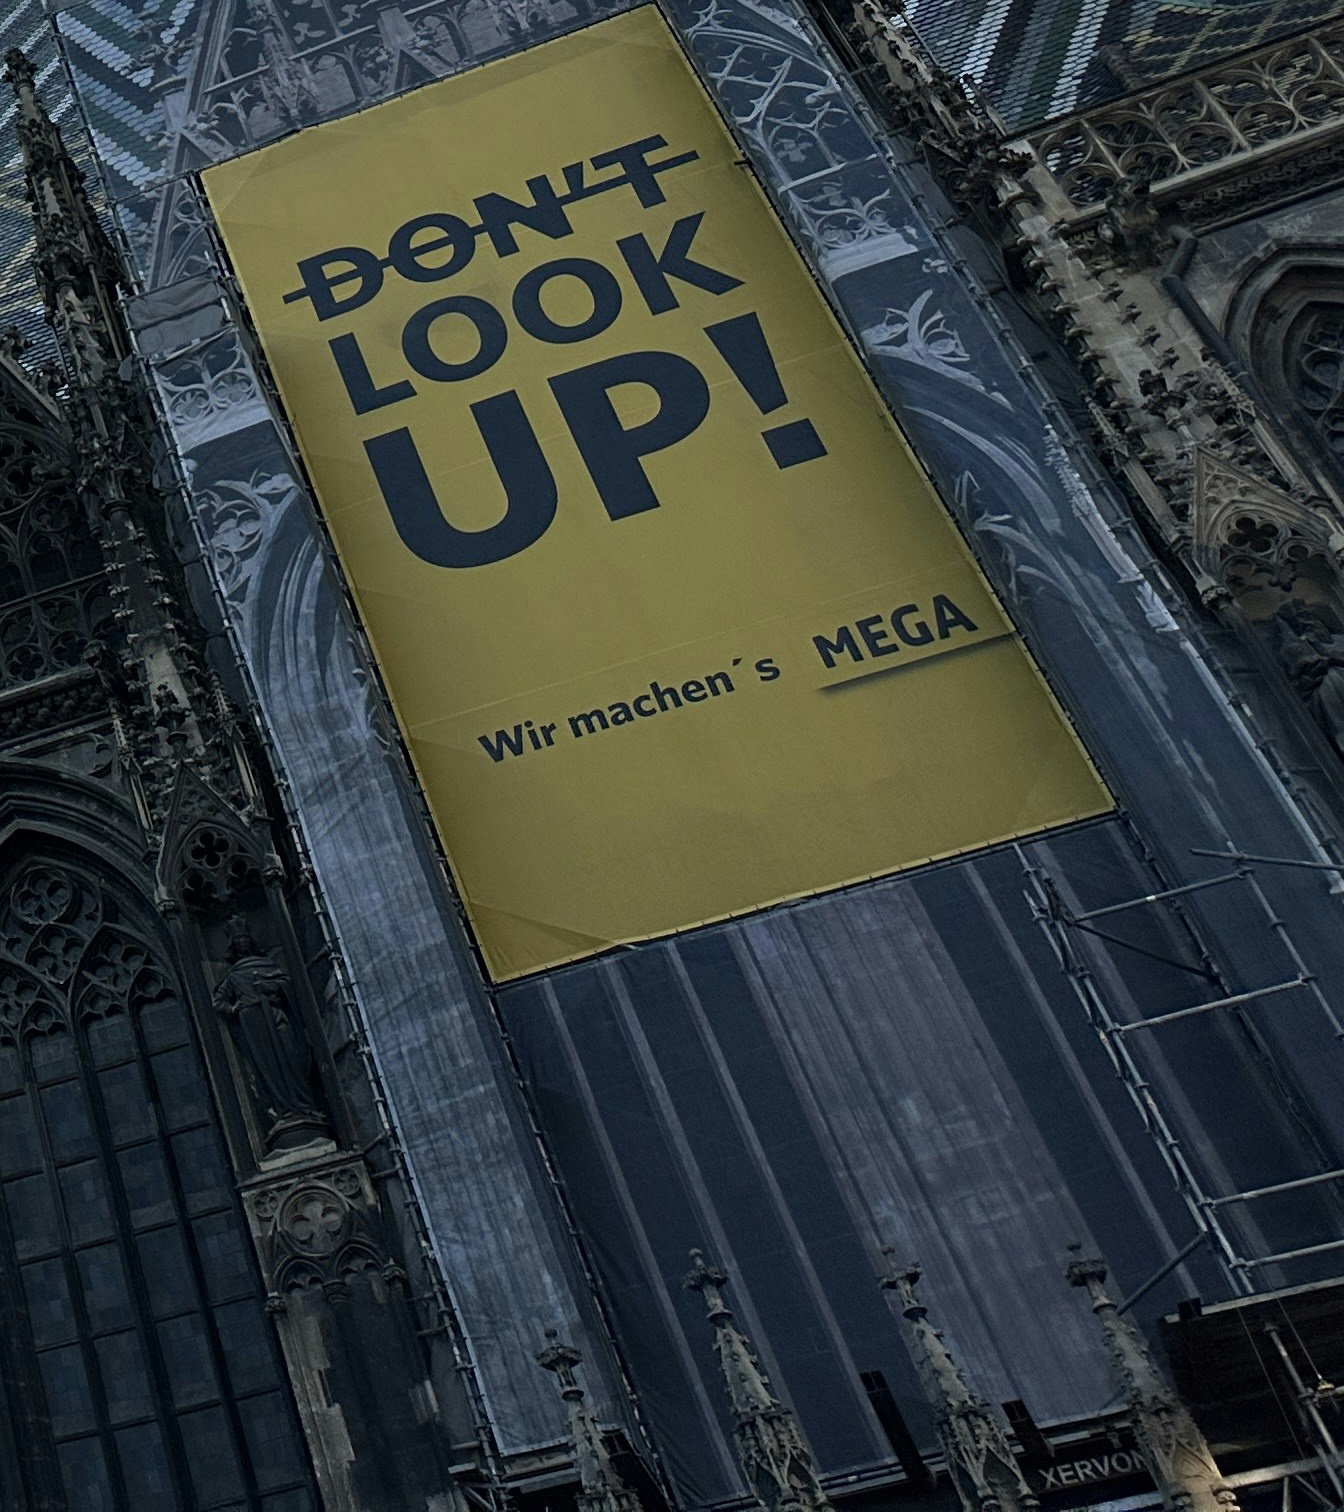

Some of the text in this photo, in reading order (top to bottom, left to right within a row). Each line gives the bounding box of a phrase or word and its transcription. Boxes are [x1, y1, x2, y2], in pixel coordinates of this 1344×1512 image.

[292, 134, 682, 322] DON'T
[328, 211, 746, 416] LOOK
[363, 311, 828, 569] UP!
[478, 720, 557, 762] Wir
[812, 593, 979, 669] MEGA
